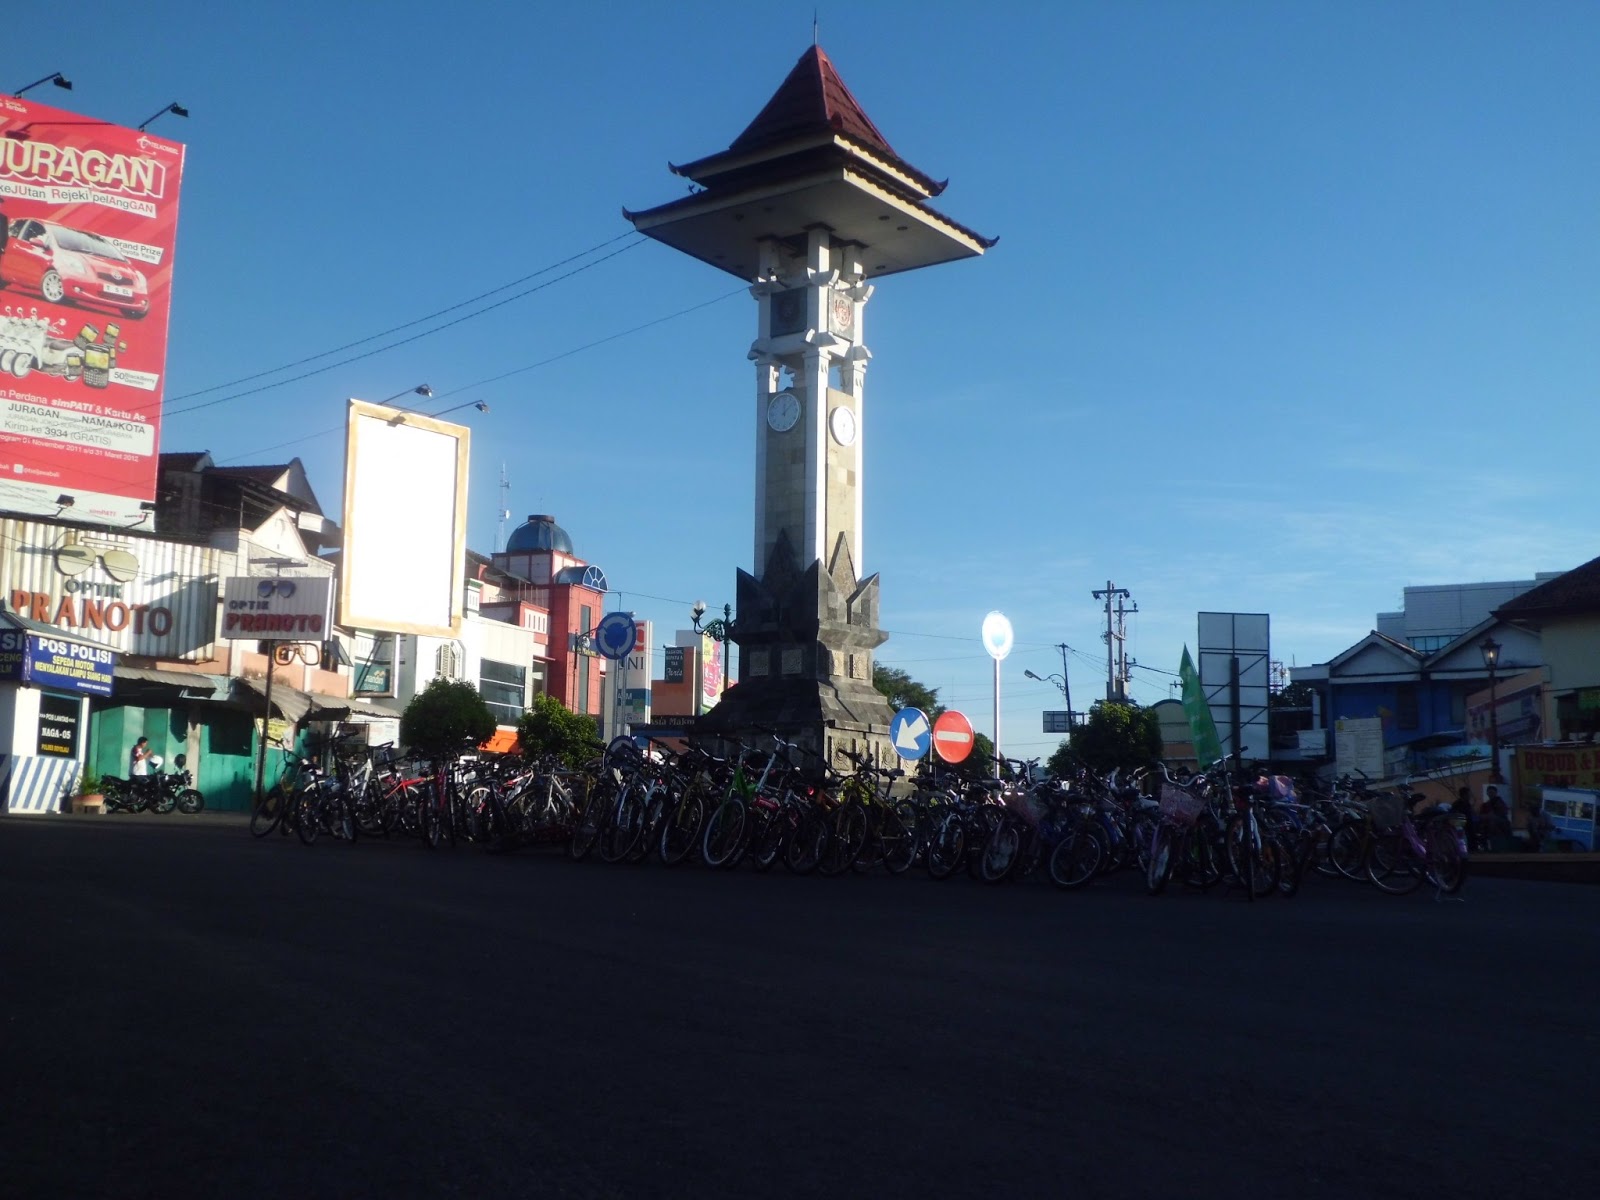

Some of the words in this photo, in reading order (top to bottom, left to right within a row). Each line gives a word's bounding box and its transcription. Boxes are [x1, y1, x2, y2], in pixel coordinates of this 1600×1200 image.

[51, 188, 89, 202] Rejeki
[92, 193, 154, 214] pelAngGAN
[112, 239, 139, 251] Grand
[140, 245, 161, 257] Prize
[114, 371, 125, 380] 50
[8, 403, 60, 419] JURAGAN
[9, 389, 48, 405] Perdana
[51, 398, 94, 412] simPATI
[104, 407, 131, 419] Kartu
[4, 420, 29, 432] Kirim
[44, 426, 68, 438] 3934
[70, 430, 112, 446] (GRATIS)
[65, 578, 124, 599] OPTIK
[11, 589, 173, 637] PRANOTO
[228, 600, 269, 610] OPTIK
[225, 613, 322, 632] PRANOTO
[39, 637, 67, 655] POS
[70, 644, 112, 665] POLISI
[52, 655, 74, 667] SEPEDA
[75, 660, 95, 671] MOTOR
[669, 716, 695, 726] Makm
[42, 727, 71, 739] NAGA-05
[1525, 751, 1576, 771] BUBUR
